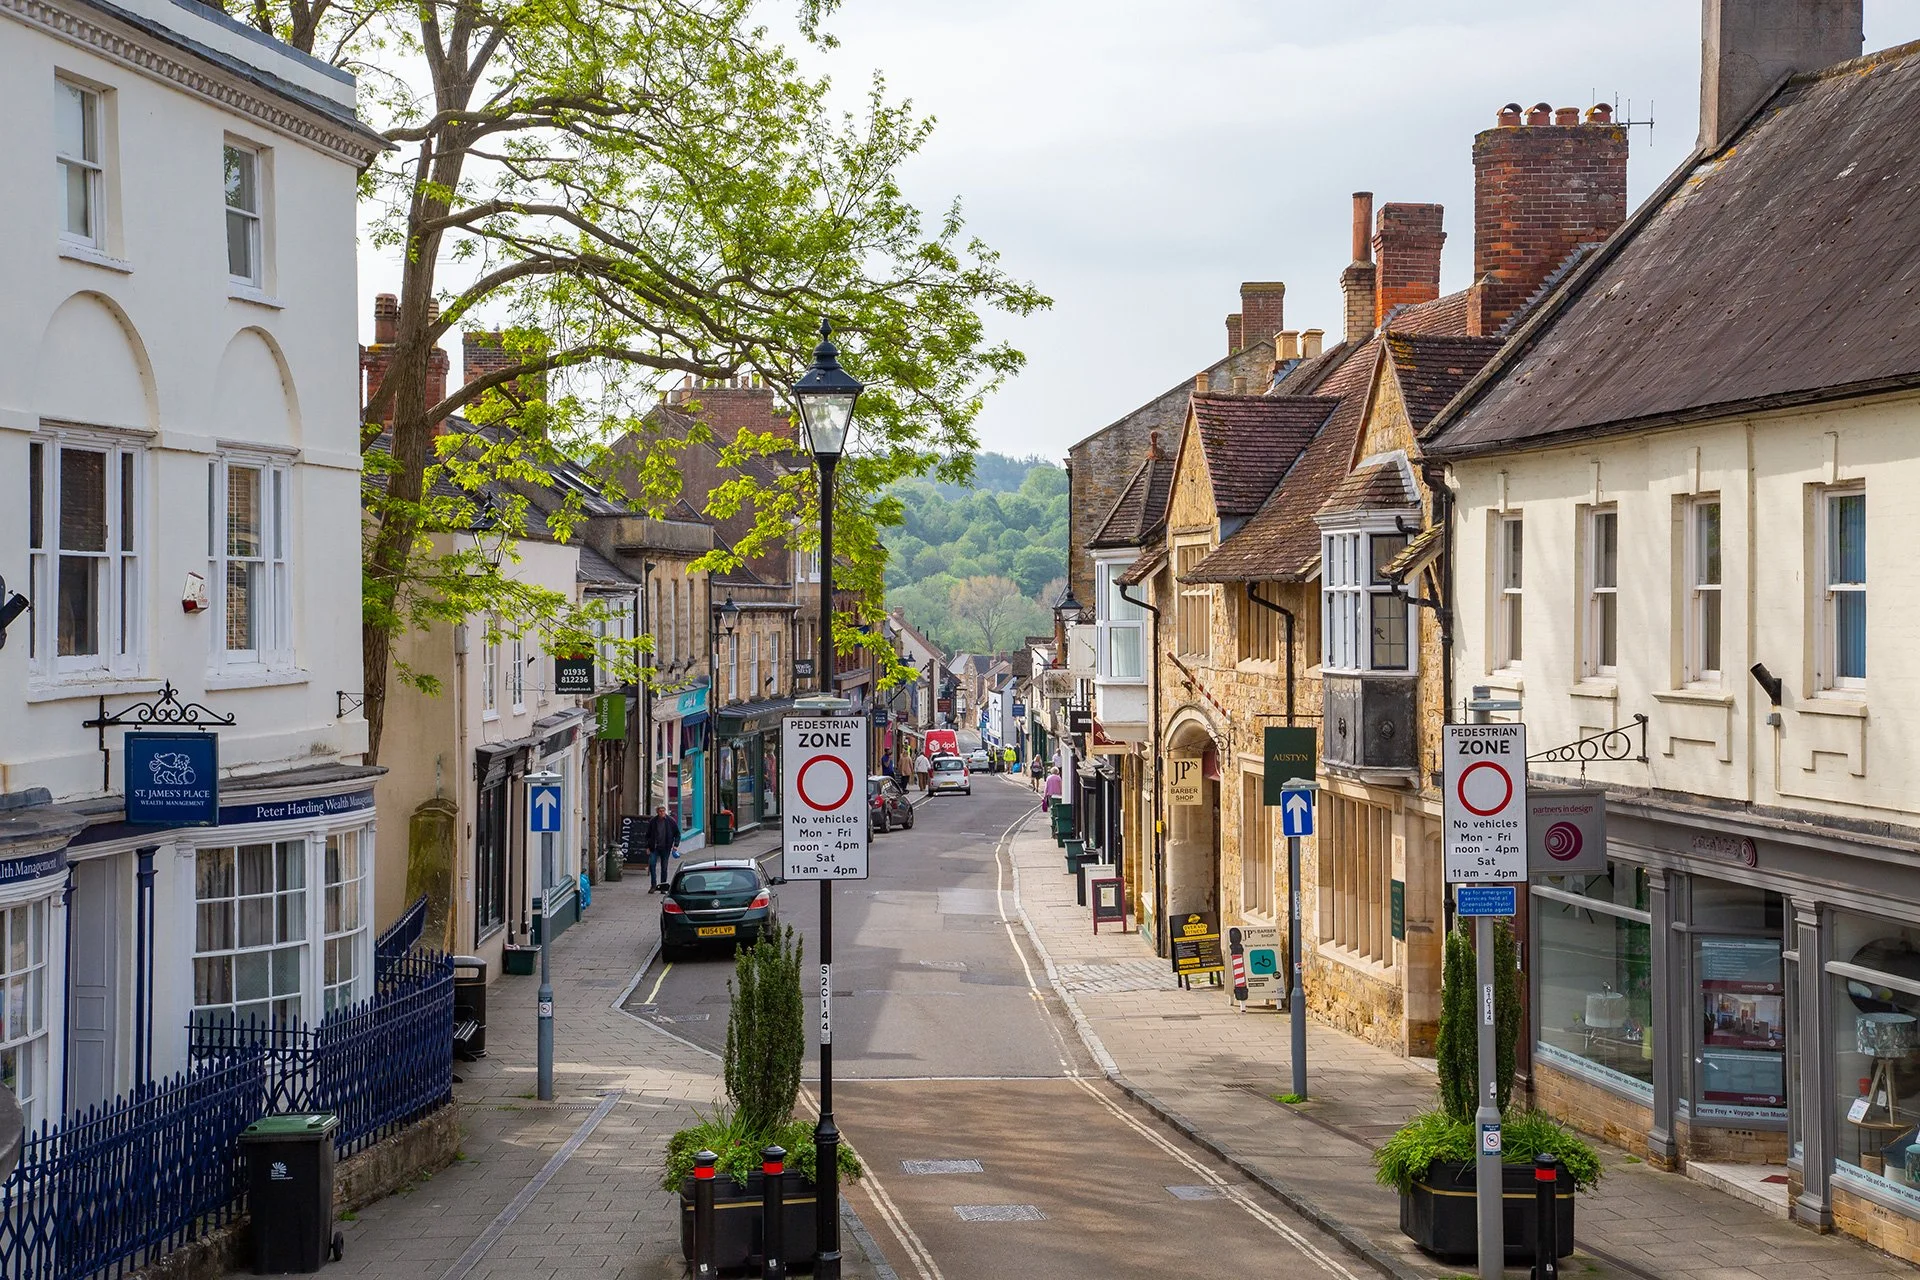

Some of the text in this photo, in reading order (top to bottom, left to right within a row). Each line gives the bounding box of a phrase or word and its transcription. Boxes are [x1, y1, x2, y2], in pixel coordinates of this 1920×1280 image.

[791, 720, 858, 729] PEDESTRIAN
[1451, 728, 1517, 737] PEDESTRIAN
[799, 733, 851, 747] ZONE
[1459, 740, 1510, 754] ZONE
[134, 790, 210, 799] ST. JAMES'S PLACE
[256, 806, 284, 818] Peter
[288, 802, 324, 816] Harding
[325, 796, 349, 810] Wealth
[1533, 806, 1562, 815] partners
[1570, 805, 1593, 814] design
[812, 815, 858, 823] vehicles
[1473, 820, 1518, 828] vehicles
[838, 828, 851, 837] Fri
[835, 841, 859, 851] 4pm
[1495, 845, 1519, 855] 4pm
[833, 866, 858, 875] 4pm
[1494, 869, 1518, 878] 4pm
